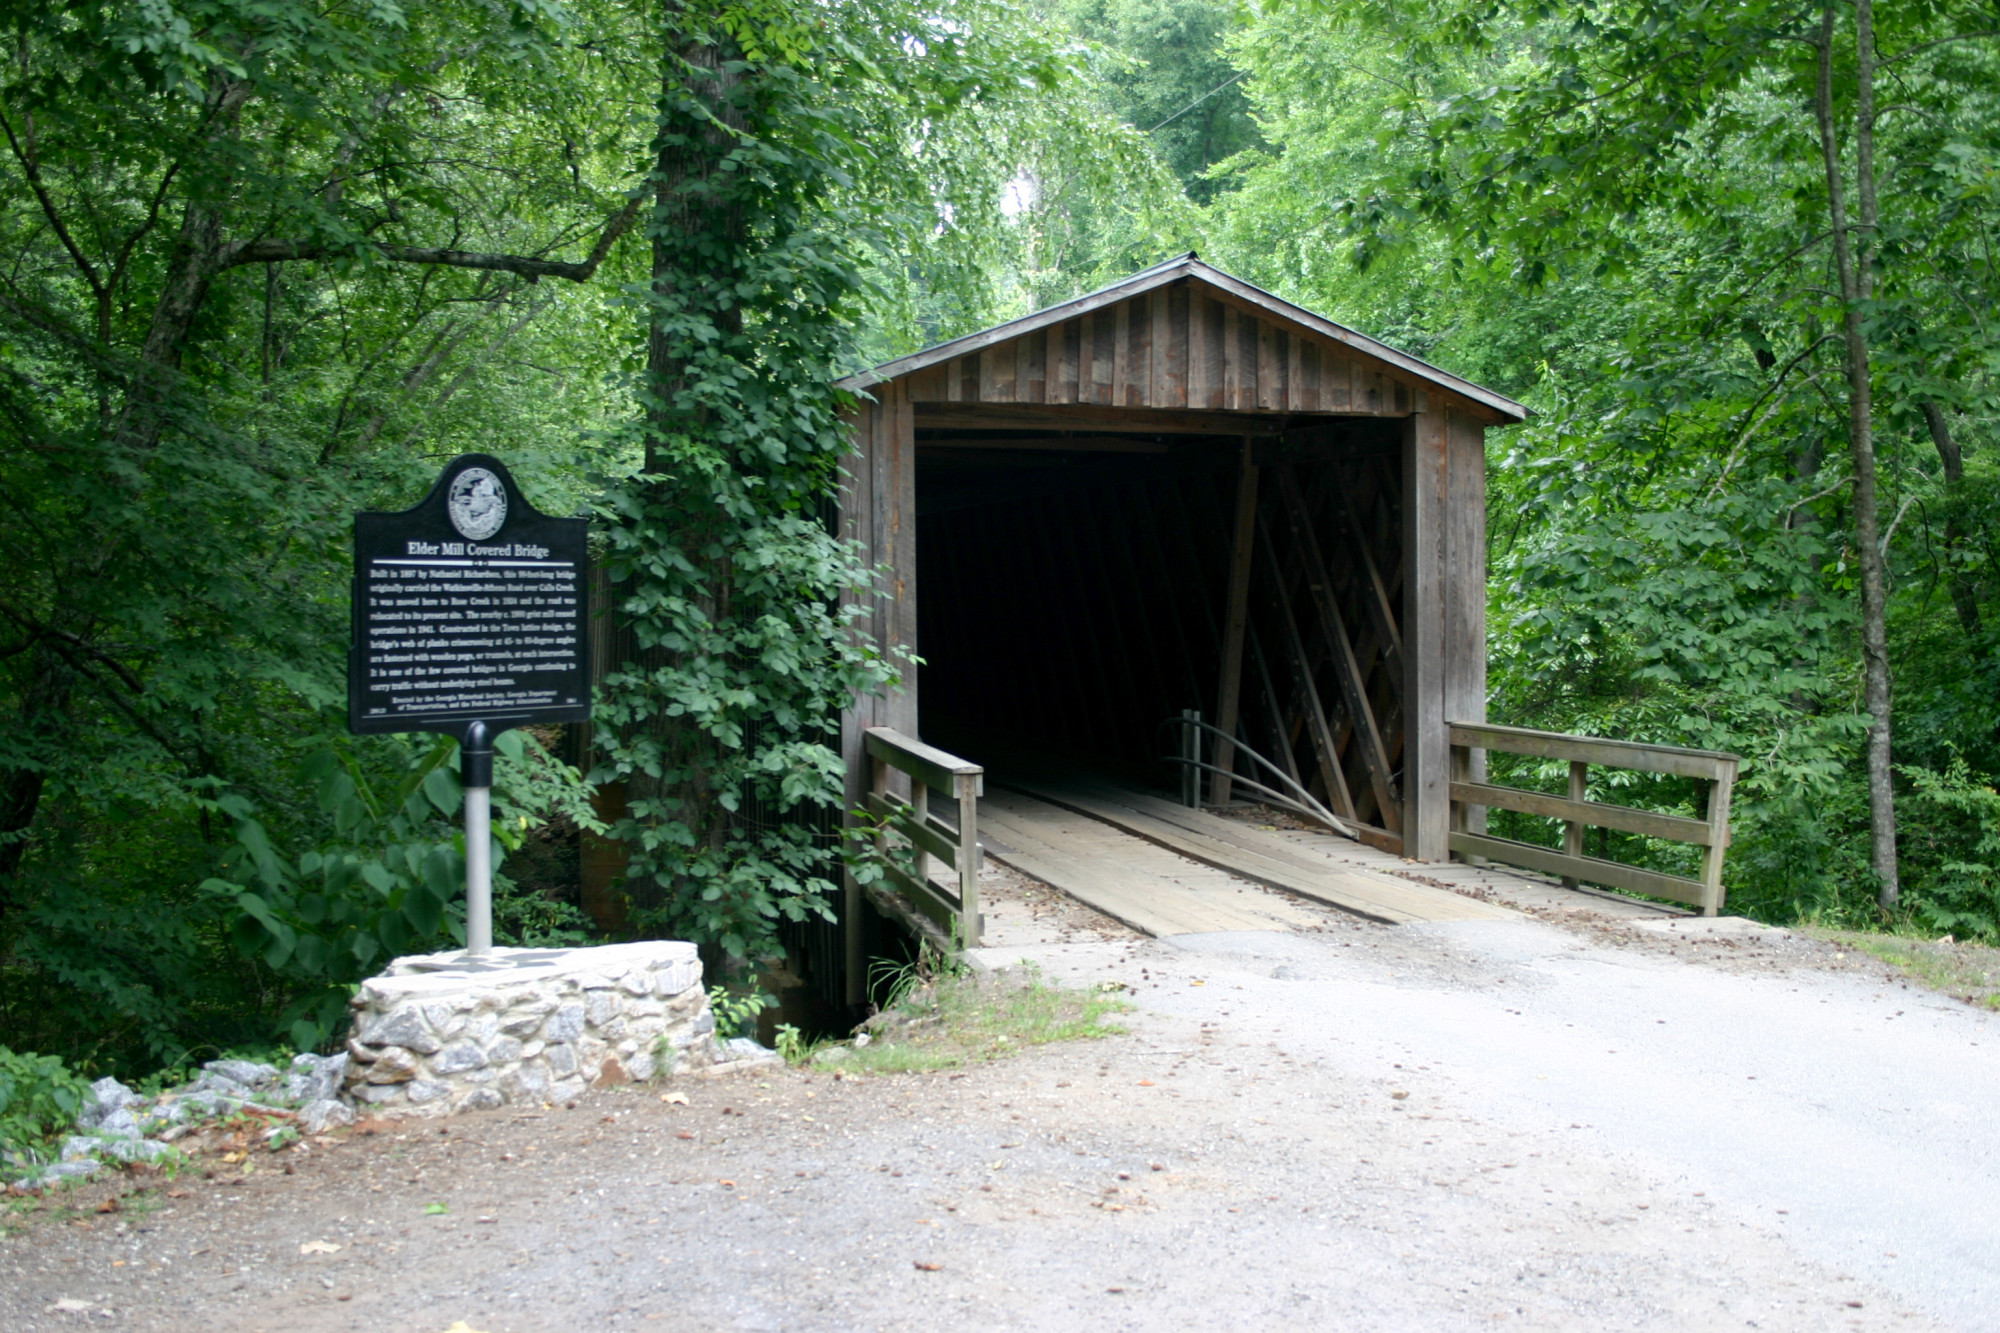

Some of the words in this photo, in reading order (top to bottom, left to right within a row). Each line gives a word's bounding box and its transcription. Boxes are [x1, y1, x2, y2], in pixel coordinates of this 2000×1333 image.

[408, 542, 439, 555] Elder
[442, 543, 464, 555] Mill
[467, 543, 512, 556] Covered
[514, 544, 550, 559] Bridge
[390, 570, 398, 578] in
[418, 569, 428, 579] by
[556, 571, 576, 579] bridge
[370, 584, 404, 593] originally
[405, 583, 429, 592] carried
[431, 584, 442, 592] the
[370, 598, 377, 606] It
[470, 597, 490, 605] Creek
[370, 612, 403, 620] relocated
[423, 612, 448, 621] present
[466, 611, 479, 619] The
[481, 610, 502, 619] nearby
[370, 626, 407, 636] operations
[409, 626, 416, 634] in
[440, 625, 480, 633] Constructed
[481, 624, 488, 632] in
[490, 624, 501, 632] the
[370, 640, 399, 650] bridge's
[401, 640, 415, 648] web
[417, 639, 425, 647] of
[427, 639, 449, 648] planks
[556, 636, 576, 645] angles
[383, 654, 413, 662] fastened
[415, 653, 429, 661] with
[431, 652, 456, 660] wooden
[370, 669, 377, 677] It
[379, 669, 387, 677] is
[414, 667, 427, 675] the
[443, 666, 470, 674] covered
[472, 665, 496, 673] bridges
[498, 664, 505, 672] in
[508, 664, 533, 672] Georgia
[370, 684, 390, 692] carry
[392, 681, 412, 690] traffic
[414, 681, 440, 689] without
